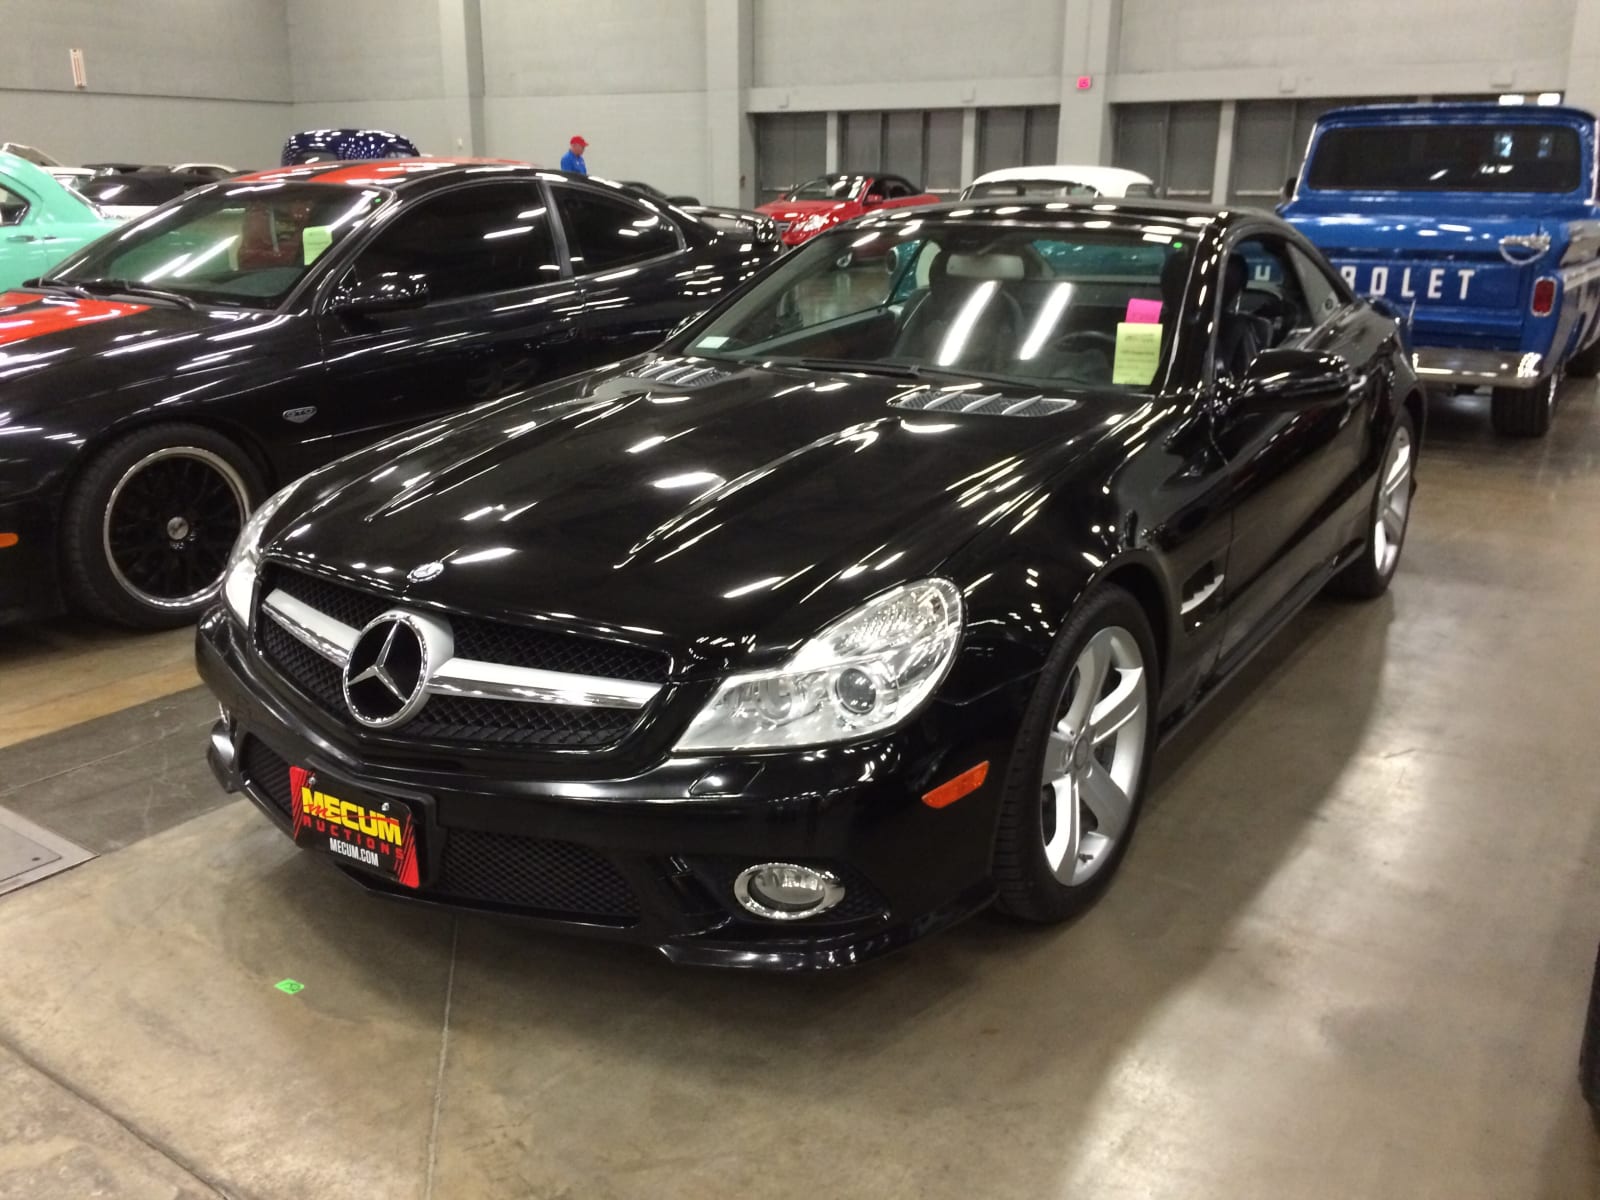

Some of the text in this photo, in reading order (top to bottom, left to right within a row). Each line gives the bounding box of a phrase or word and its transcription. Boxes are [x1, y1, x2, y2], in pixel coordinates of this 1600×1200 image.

[301, 786, 402, 846] MECUM
[302, 815, 404, 860] AUCTIONS
[329, 837, 379, 867] MECUM.COM
